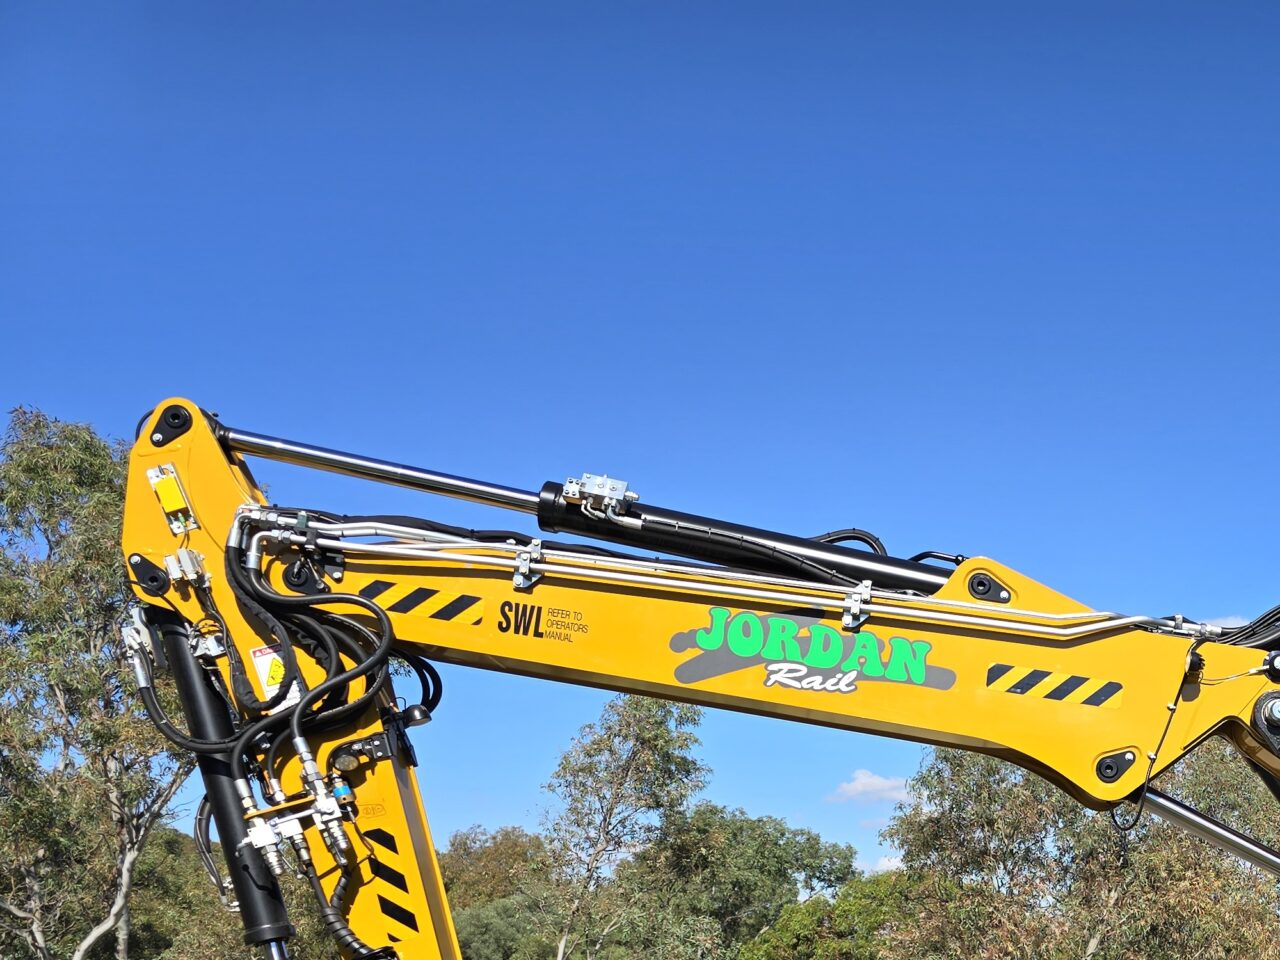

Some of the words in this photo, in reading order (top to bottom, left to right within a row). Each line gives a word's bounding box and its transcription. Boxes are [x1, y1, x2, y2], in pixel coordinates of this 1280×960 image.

[497, 600, 544, 638] SWL
[546, 618, 589, 633] OPERATORS
[547, 607, 571, 619] REFER
[573, 611, 583, 621] TO
[544, 629, 574, 643] MANUAL
[695, 606, 932, 685] JORDAN
[766, 662, 859, 693] Rail
